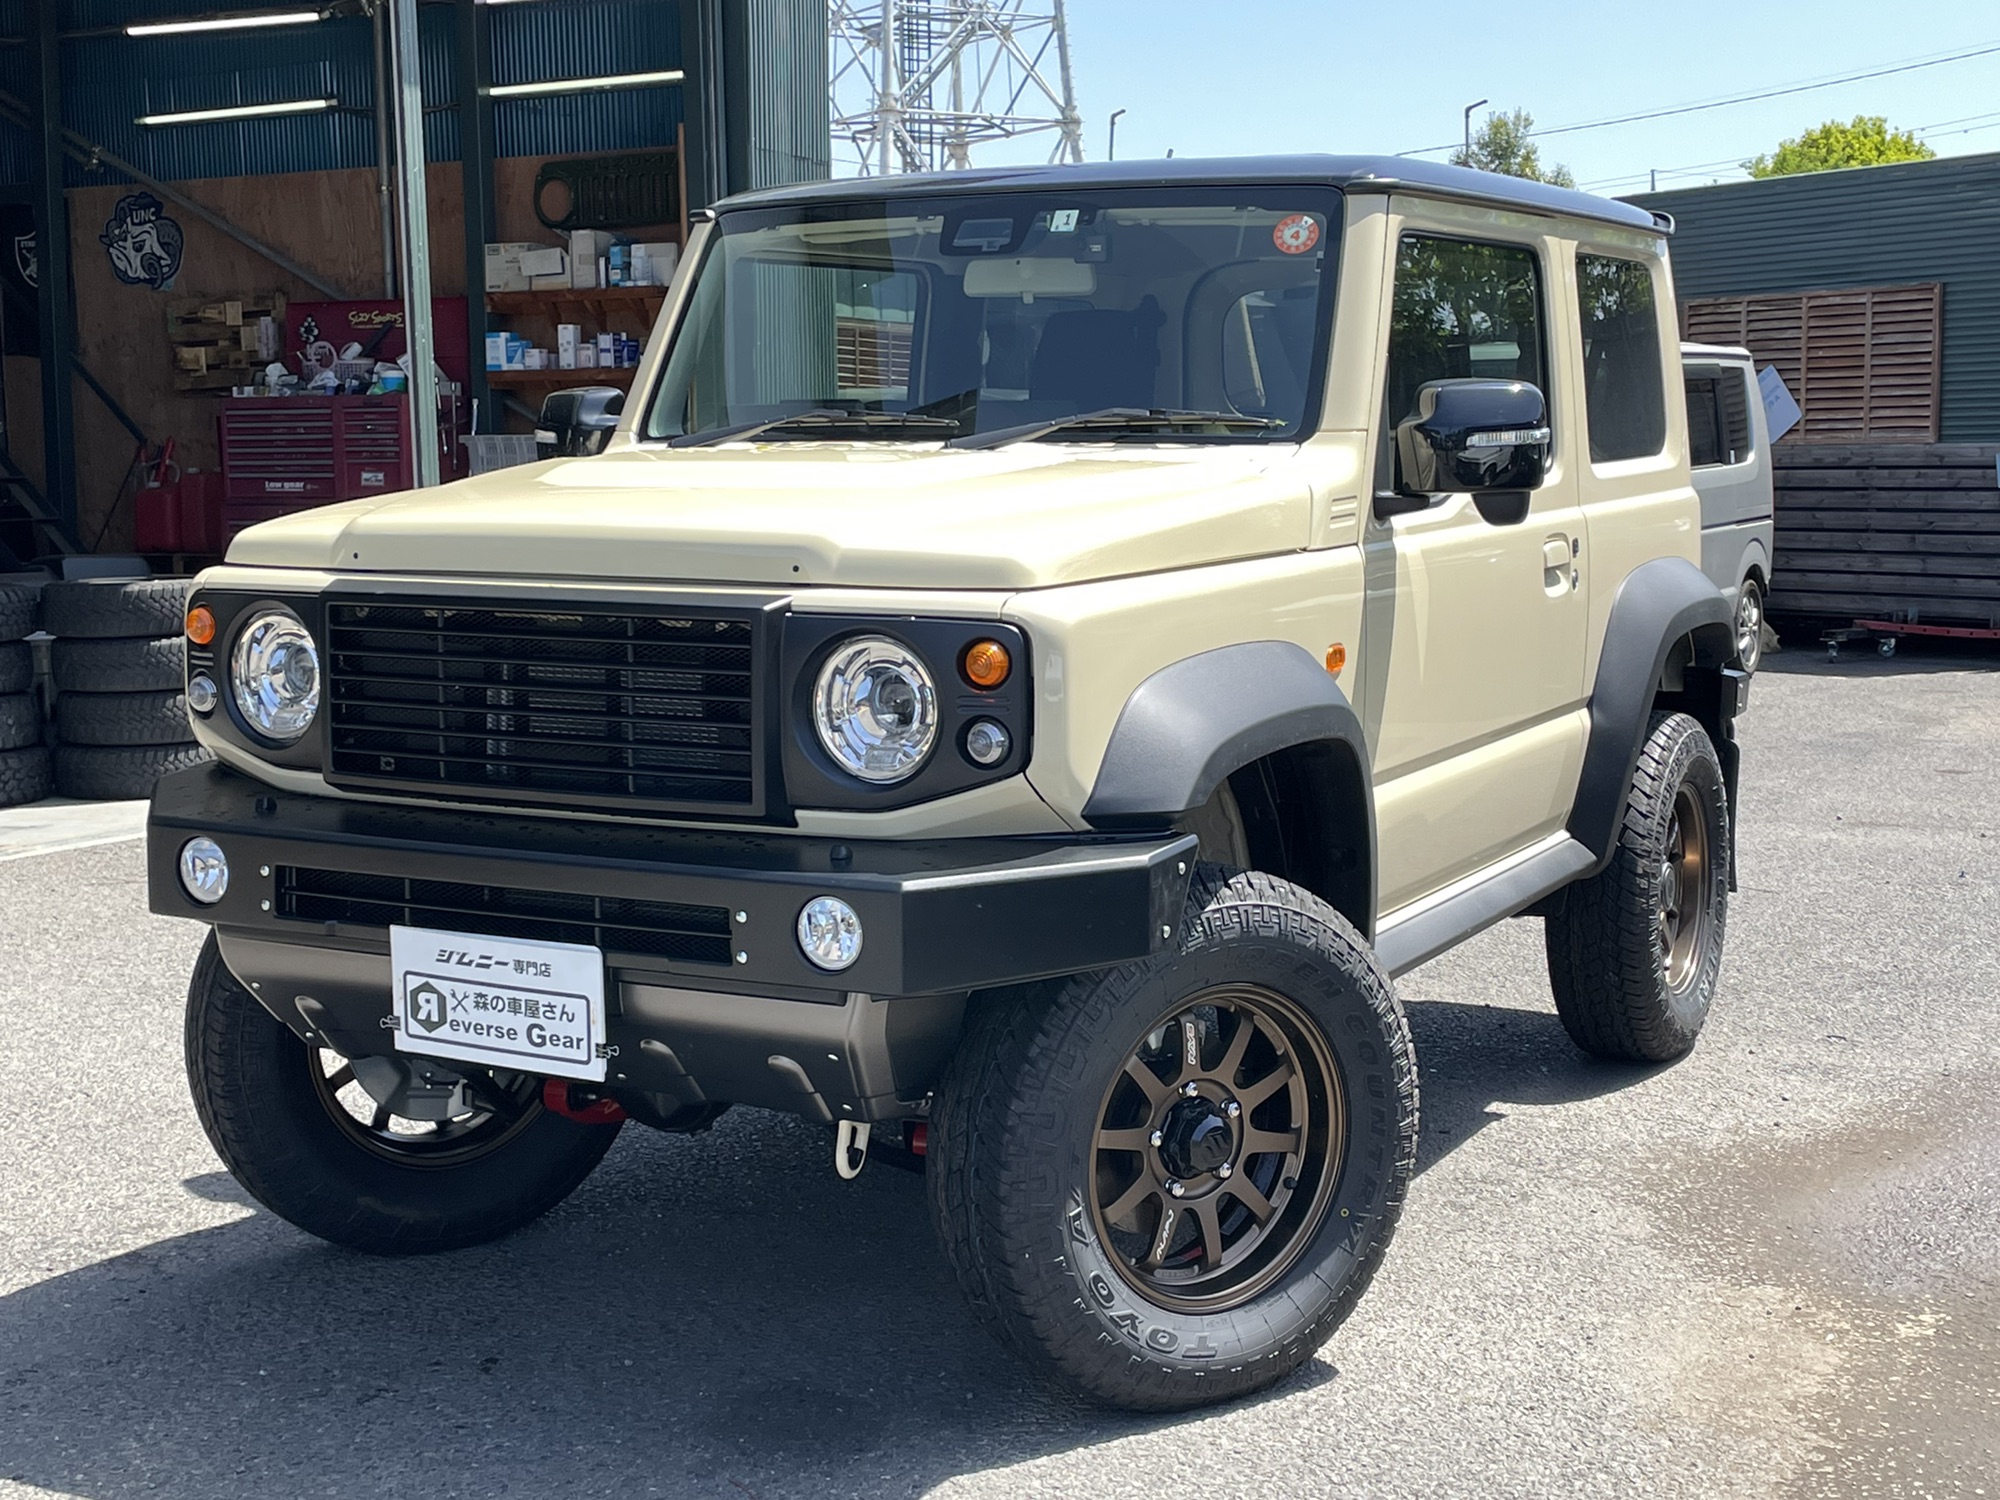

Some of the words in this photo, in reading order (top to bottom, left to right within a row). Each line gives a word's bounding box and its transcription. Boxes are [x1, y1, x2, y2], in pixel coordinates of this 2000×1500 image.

[132, 207, 157, 224] UNC
[1063, 213, 1071, 226] 1
[1290, 229, 1300, 242] 4
[265, 480, 282, 488] Low
[283, 481, 305, 489] gear
[473, 991, 575, 1023] 森の車屋さん
[526, 1023, 584, 1050] Gear
[1186, 1022, 1196, 1065] RAYS
[1238, 944, 1343, 1000] OPEN
[1337, 1009, 1389, 1256] COUNTRY
[1088, 1270, 1218, 1358] TOYO
